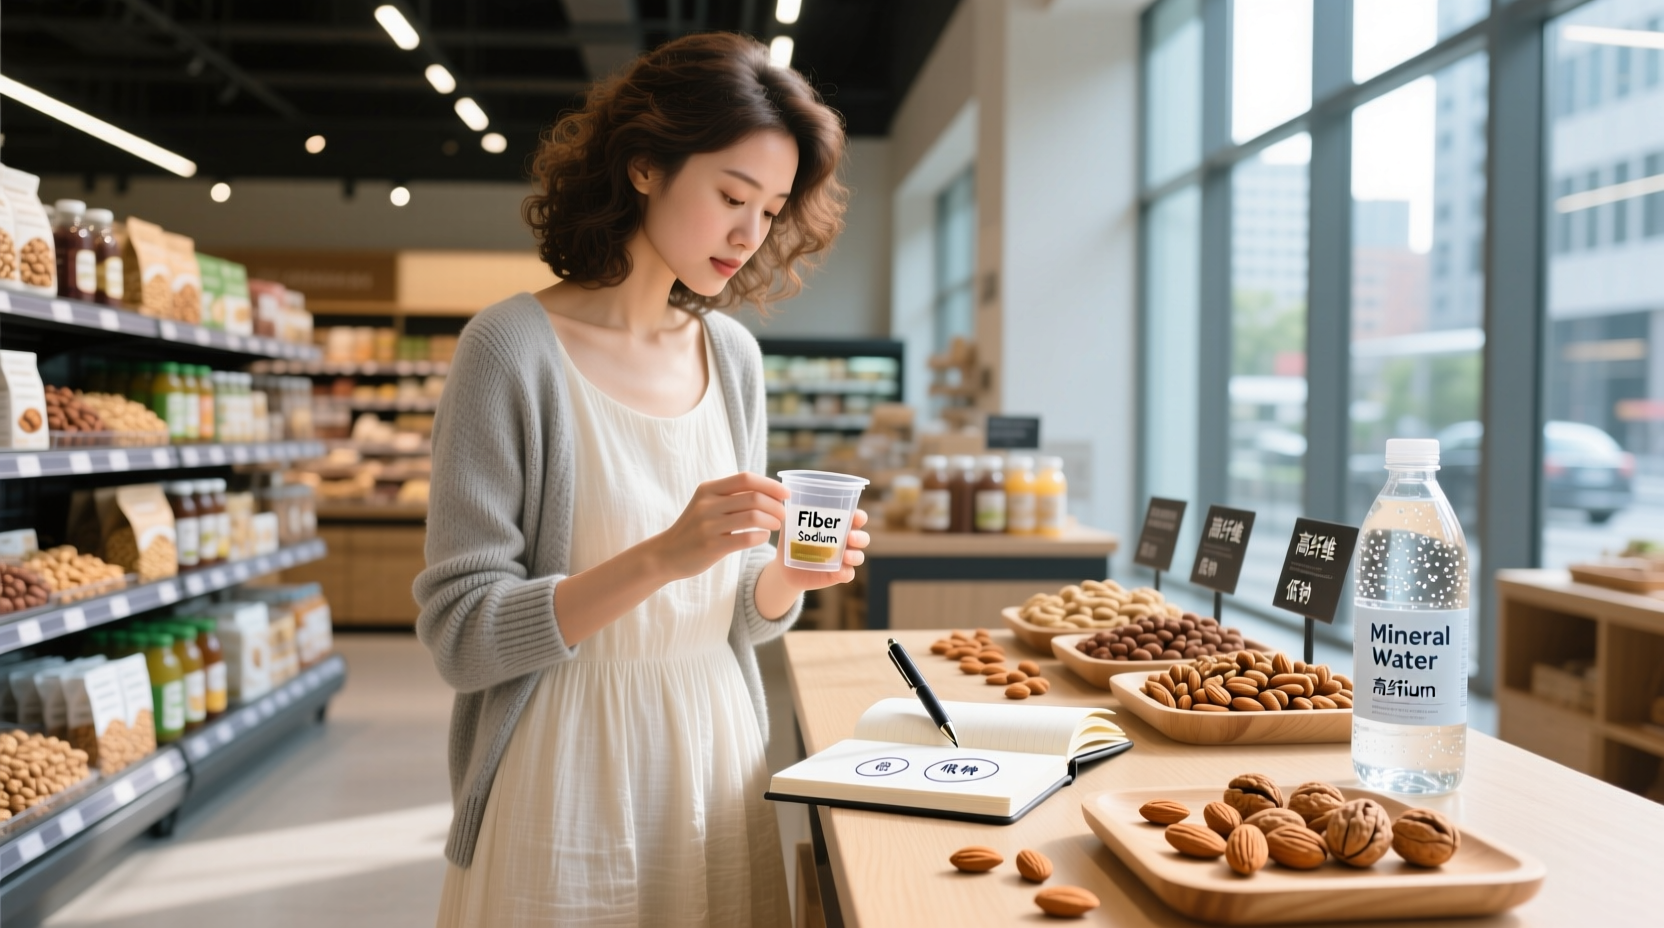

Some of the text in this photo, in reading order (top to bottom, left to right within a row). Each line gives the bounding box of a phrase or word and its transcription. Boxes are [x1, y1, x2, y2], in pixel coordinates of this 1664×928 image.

[798, 511, 841, 529] Fiber
[798, 530, 838, 544] Sodium
[1371, 622, 1450, 646] Mineral
[1372, 646, 1438, 670] Water
